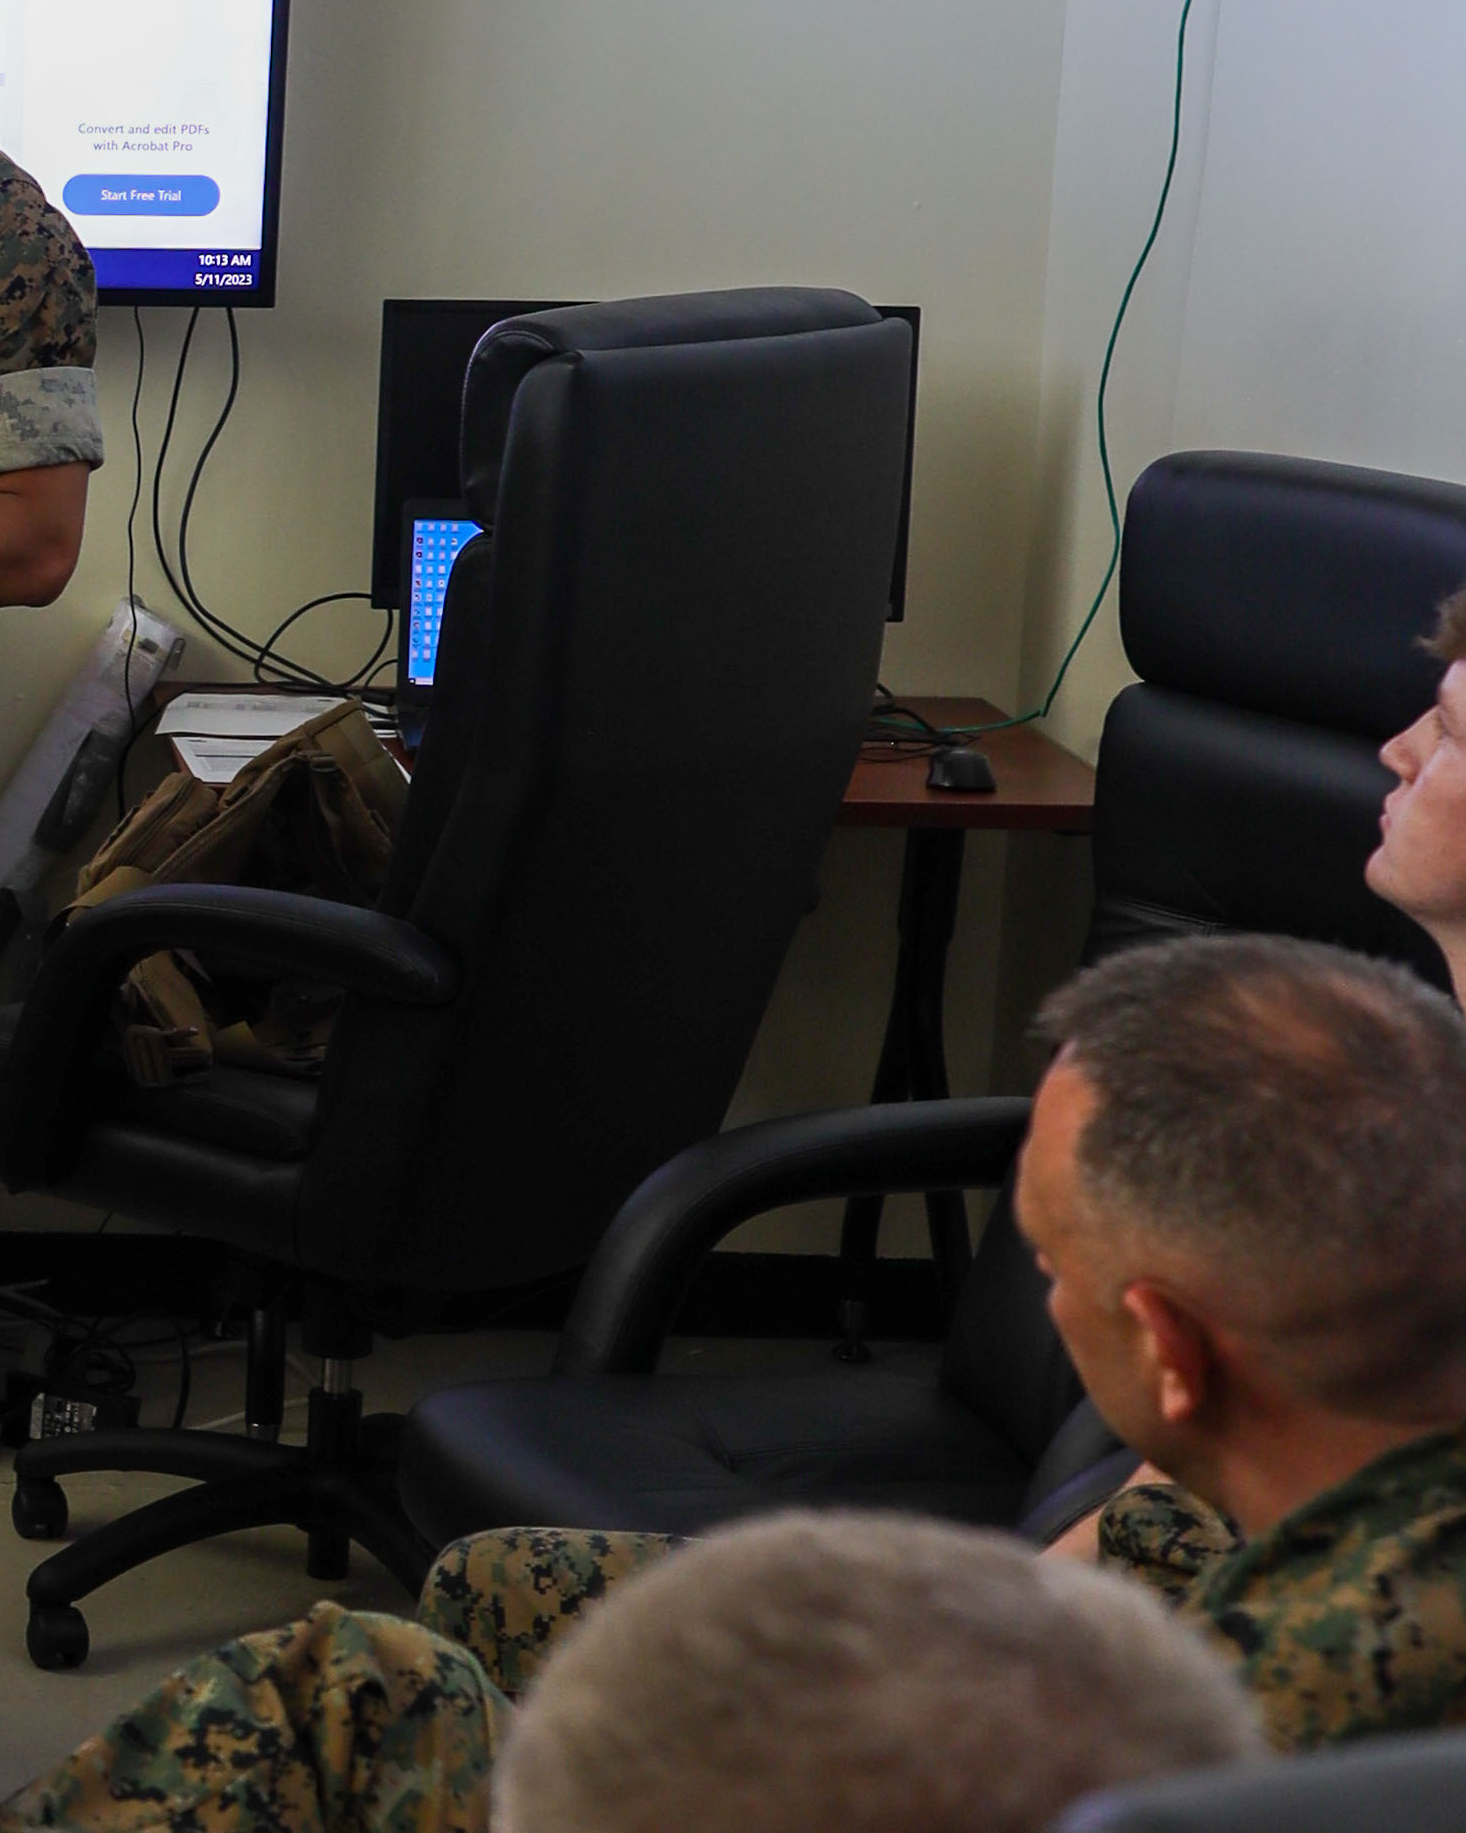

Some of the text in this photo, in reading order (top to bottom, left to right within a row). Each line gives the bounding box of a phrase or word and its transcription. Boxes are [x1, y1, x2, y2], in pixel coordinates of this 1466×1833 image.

[78, 123, 209, 134] Convert and edit PDFs
[93, 140, 193, 151] with Acrobat Pro
[101, 188, 182, 201] Start Free Trial
[199, 254, 251, 266] 10:13 AM
[195, 273, 252, 286] 5/11/2023
